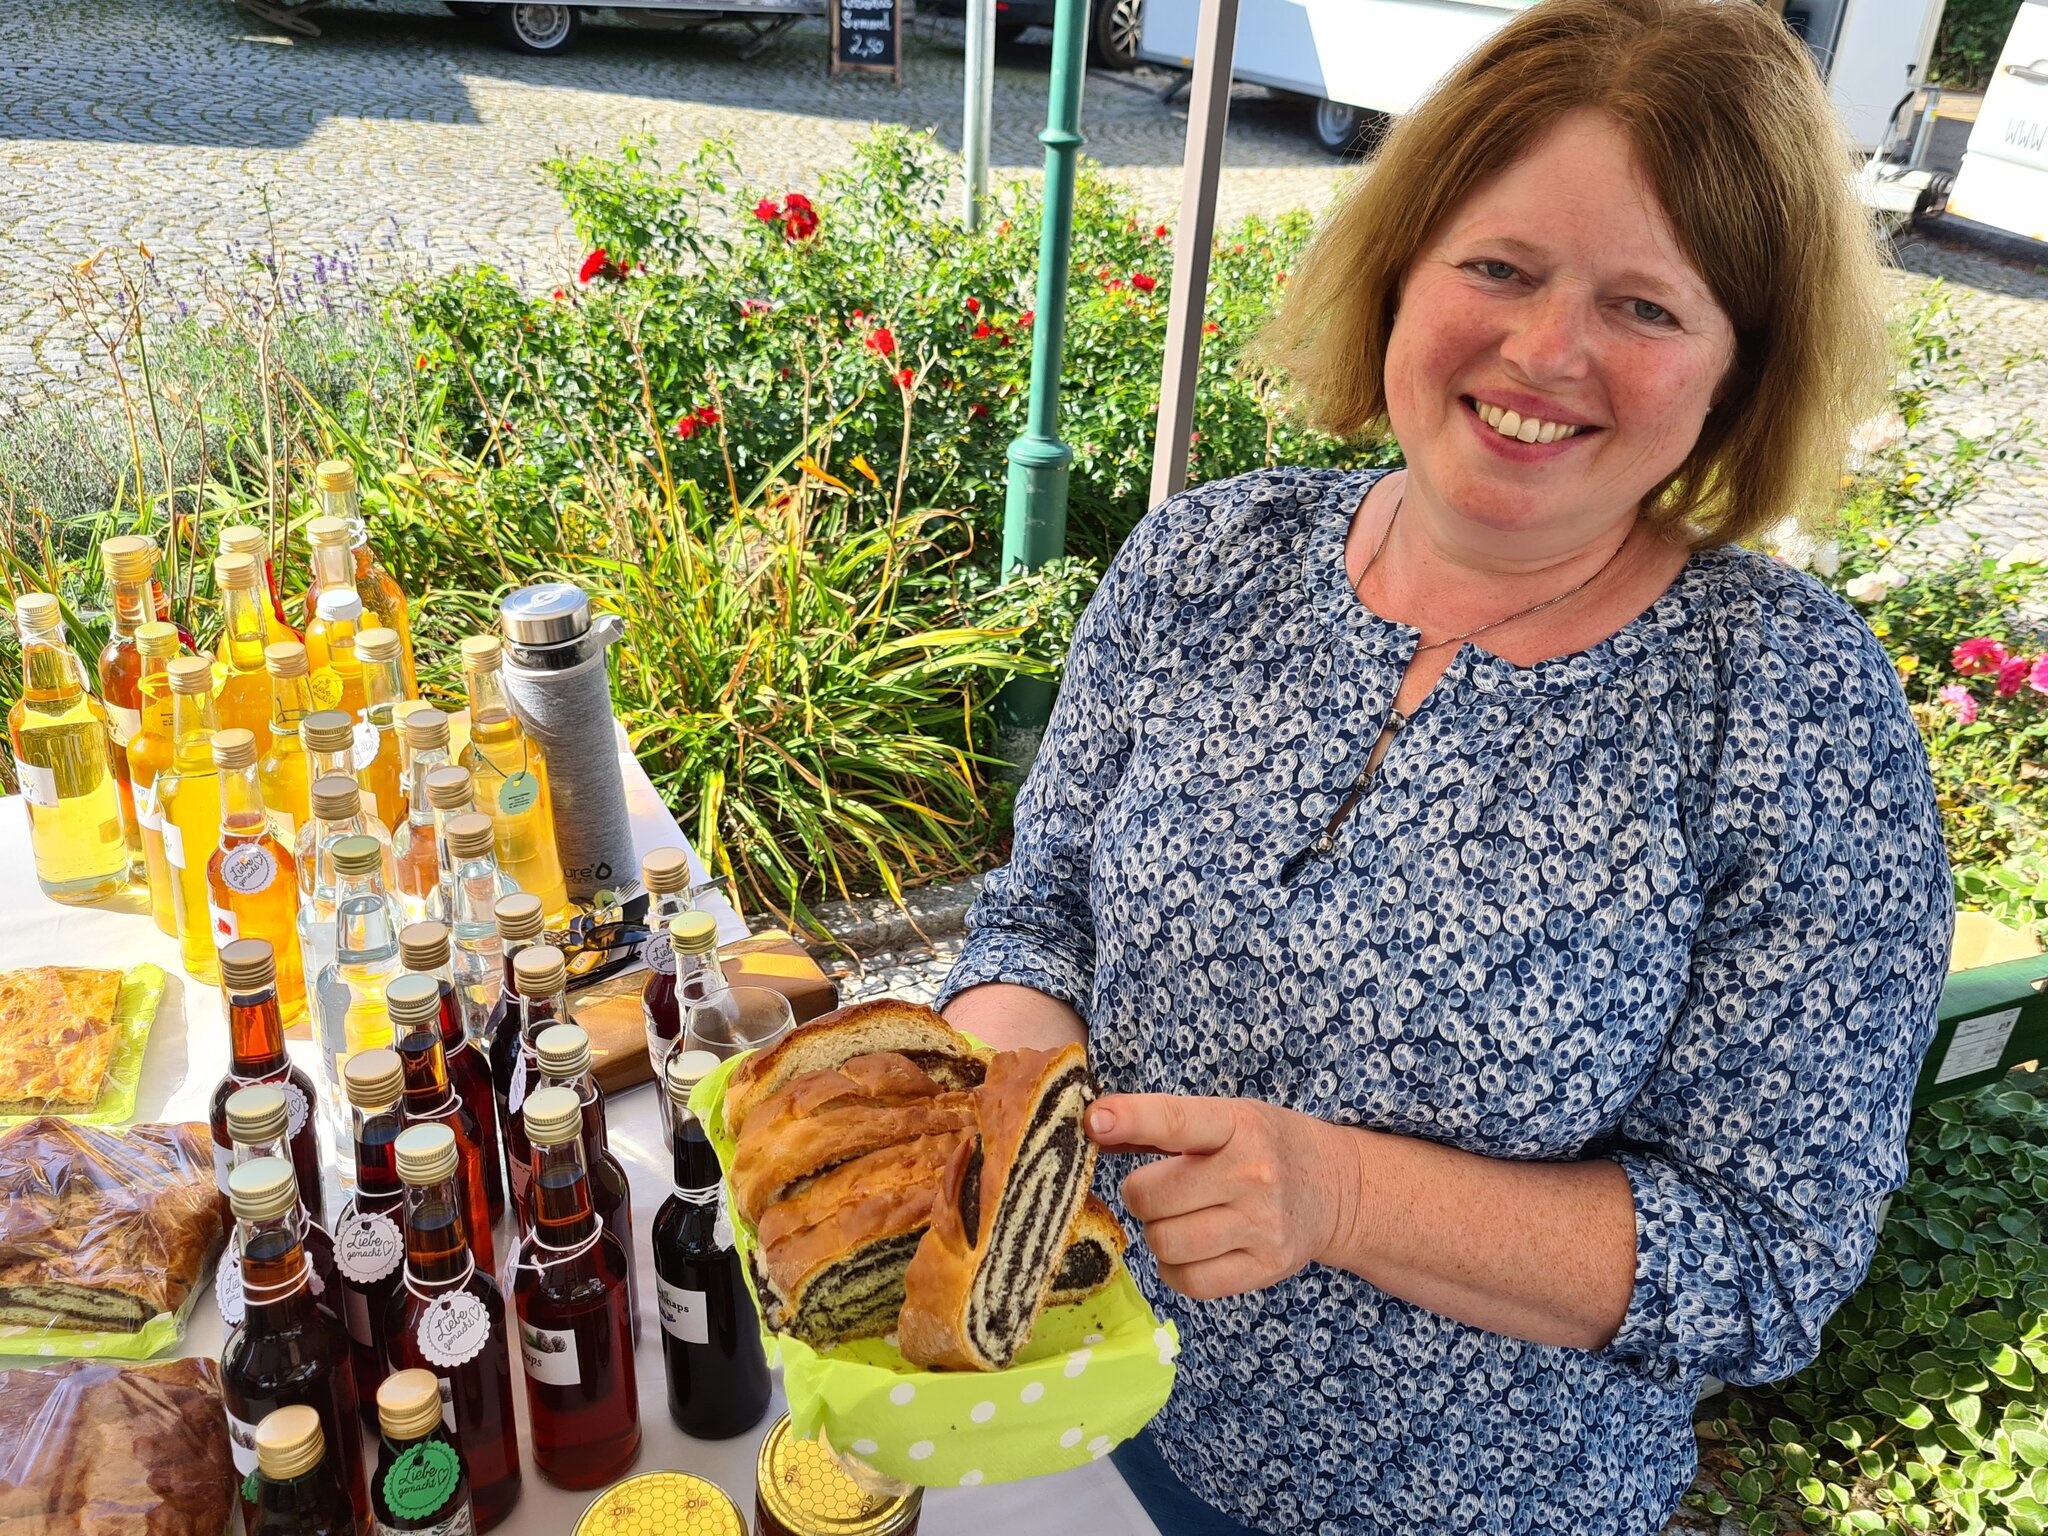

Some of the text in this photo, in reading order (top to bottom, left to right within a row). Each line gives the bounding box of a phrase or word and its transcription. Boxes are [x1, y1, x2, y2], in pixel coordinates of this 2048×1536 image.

[230, 858, 254, 881] Liebe
[565, 867, 593, 884] ure
[652, 943, 673, 962] Lieb
[347, 1230, 382, 1249] Liebe
[347, 1248, 382, 1261] gemacht
[435, 1309, 468, 1341] Liebe
[443, 1318, 475, 1351] gemacht
[398, 1461, 438, 1485] Liebe
[398, 1478, 437, 1499] gemacht
